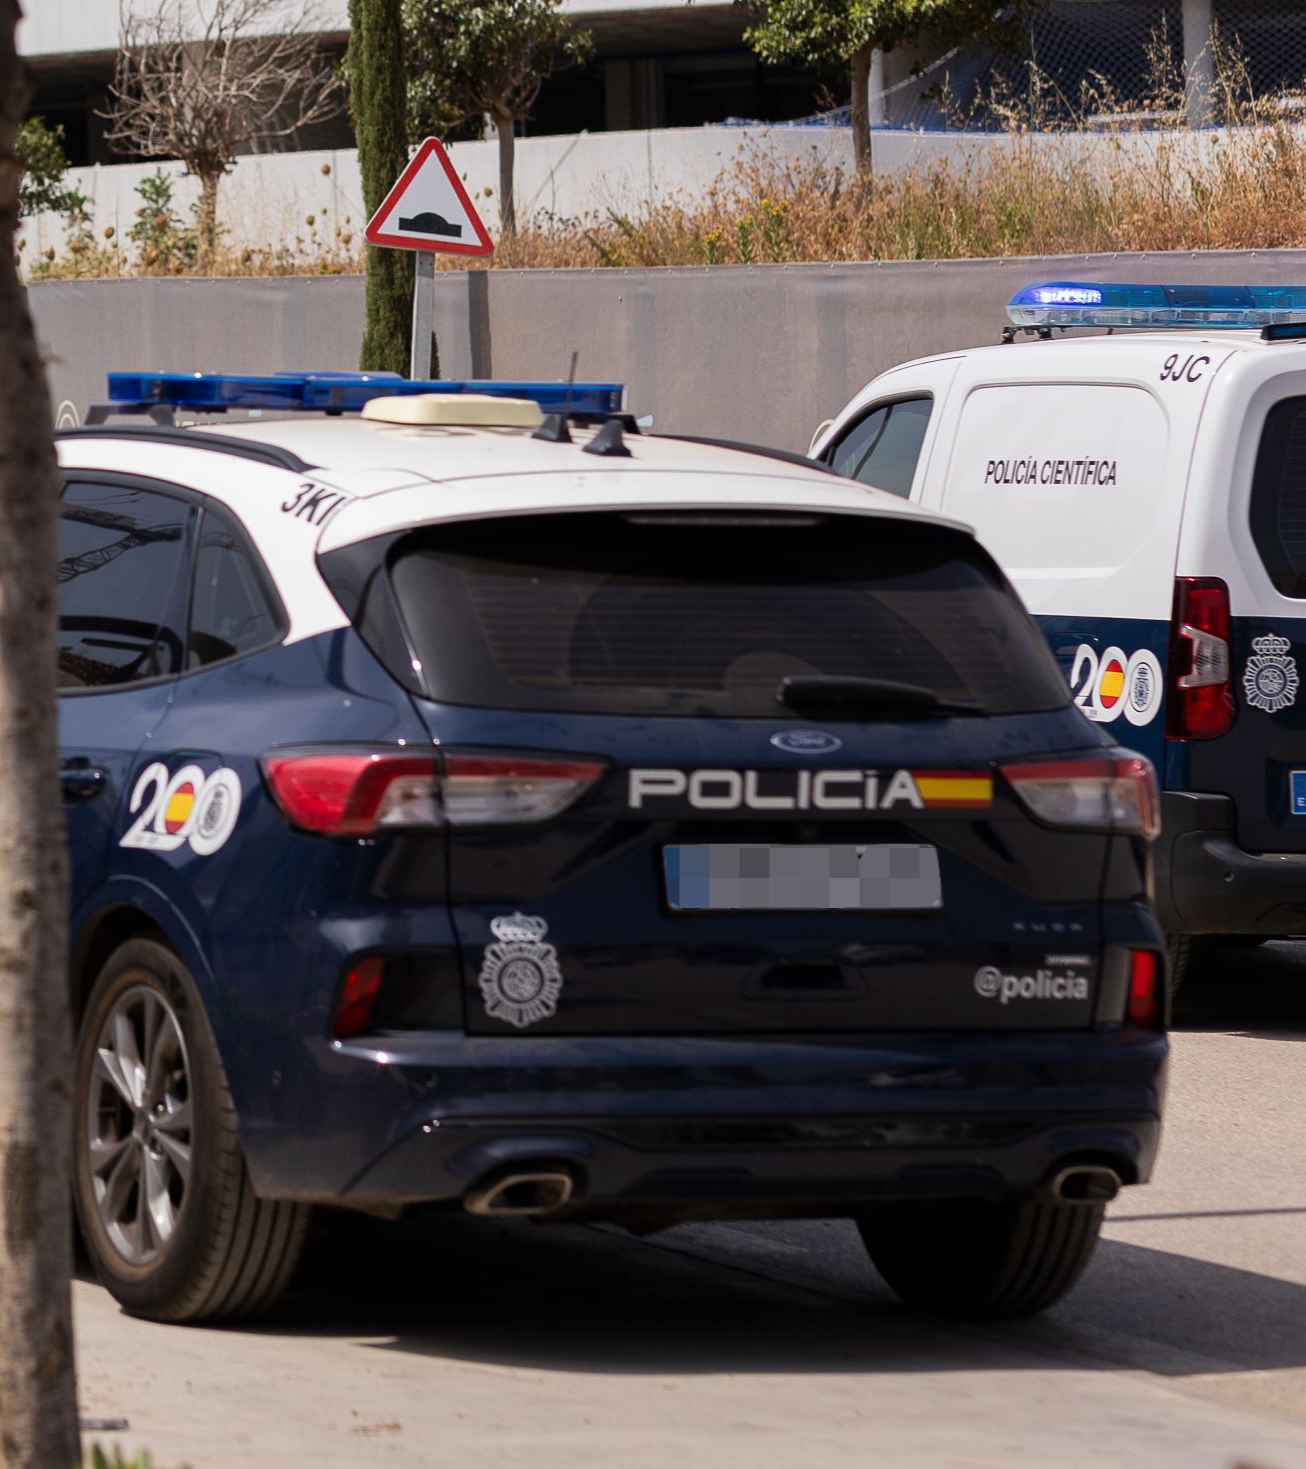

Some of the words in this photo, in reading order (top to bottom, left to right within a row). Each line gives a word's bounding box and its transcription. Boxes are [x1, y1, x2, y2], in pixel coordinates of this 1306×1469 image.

[1160, 353, 1211, 382] 9JC
[984, 456, 1038, 485] POLICÍA
[1040, 456, 1117, 486] CIENTÍFICA
[281, 483, 346, 526] 3KI
[119, 762, 243, 856] 200
[974, 965, 1089, 1005] @policia
